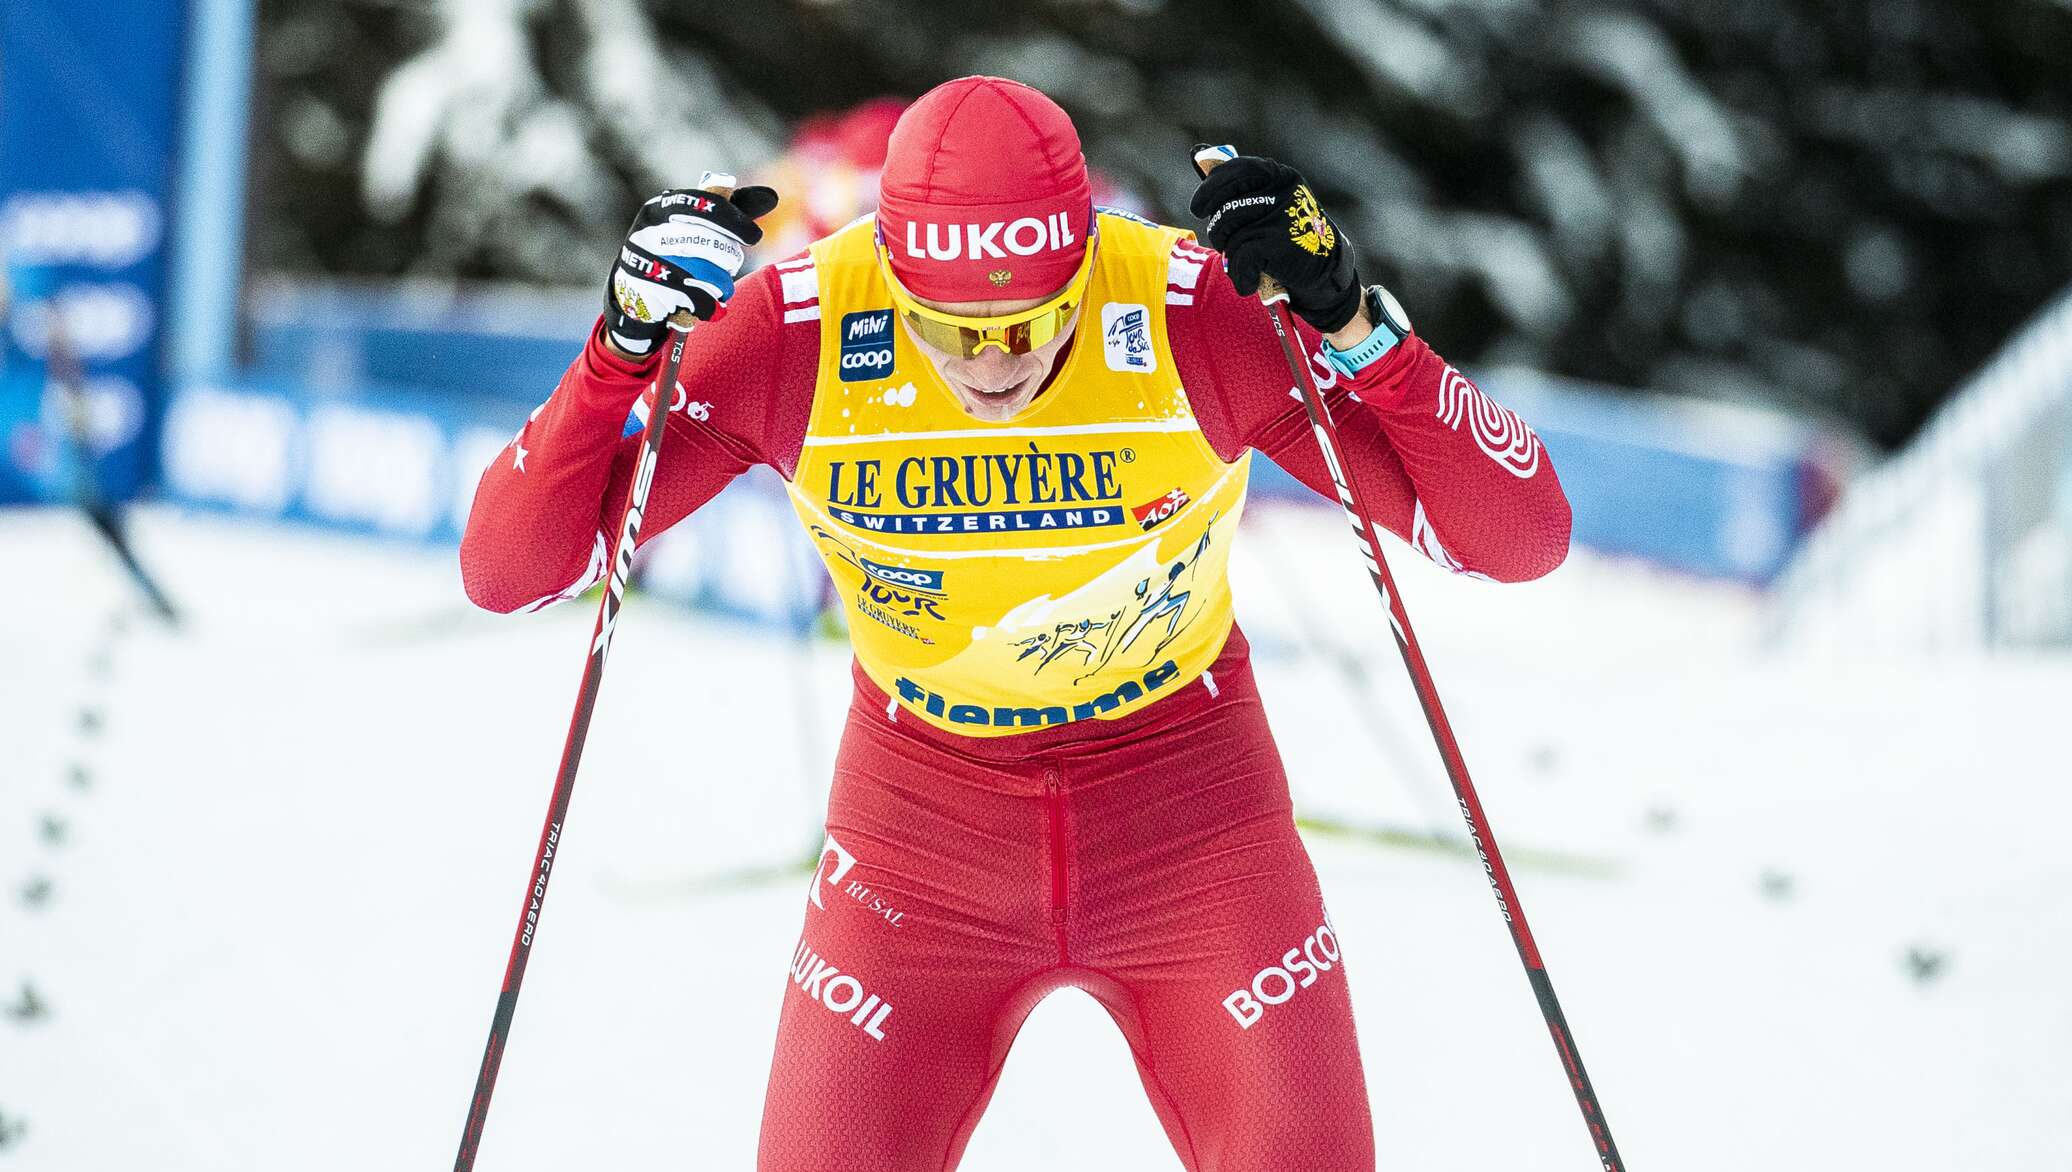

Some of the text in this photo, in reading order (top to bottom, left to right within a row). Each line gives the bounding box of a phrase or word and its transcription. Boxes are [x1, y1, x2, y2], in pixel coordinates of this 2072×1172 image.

[1222, 196, 1276, 213] Alexander
[660, 235, 712, 246] Alexander
[906, 211, 1075, 261] LUKOIL
[671, 341, 685, 364] TCS
[841, 349, 893, 369] coop
[827, 461, 882, 508] LE
[840, 509, 1111, 532] SWITZERLAND
[540, 822, 561, 873] TRIAC
[844, 880, 905, 928] RUSAL
[521, 898, 540, 946] AERO
